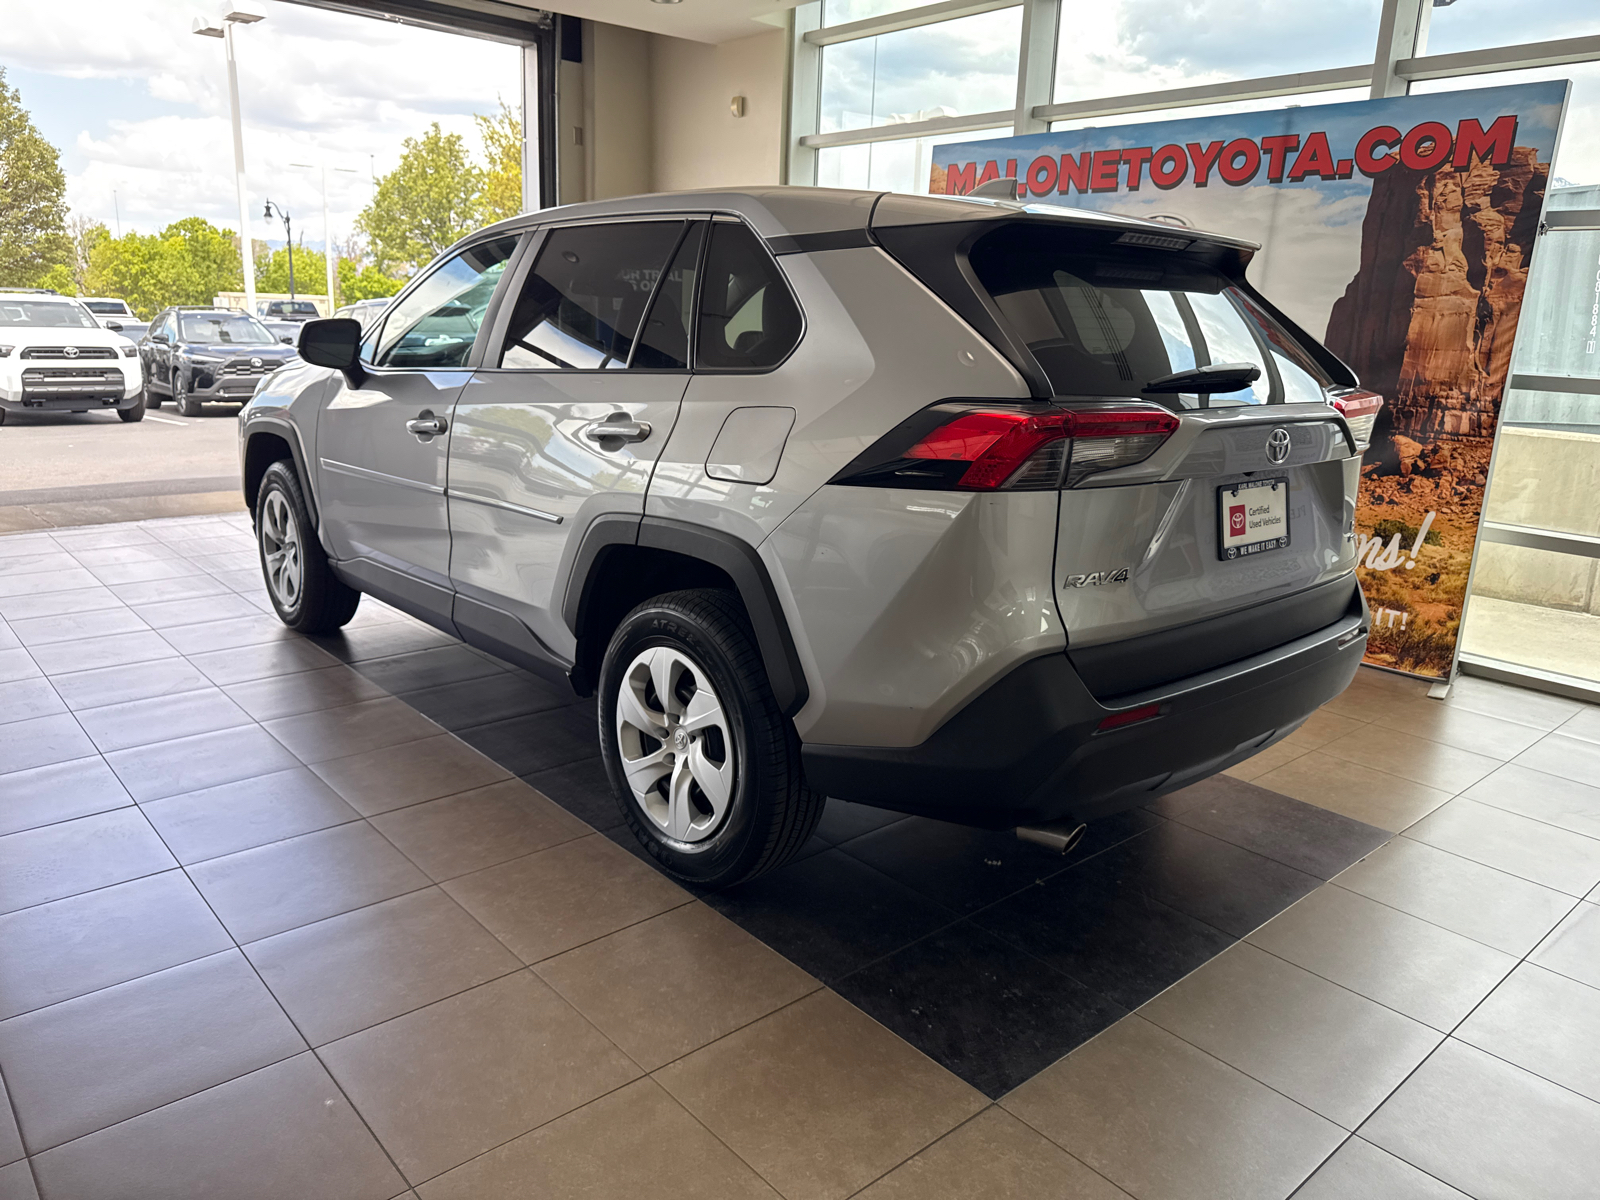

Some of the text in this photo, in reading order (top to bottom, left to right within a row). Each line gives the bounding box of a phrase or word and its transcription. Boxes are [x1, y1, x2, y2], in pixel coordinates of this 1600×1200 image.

[643, 269, 682, 281] TRAL
[1249, 504, 1270, 517] Certified
[1249, 516, 1281, 529] Used Vehicles
[1240, 540, 1276, 555] WE MAKE IT EASY
[1355, 511, 1436, 571] ns!
[1063, 567, 1130, 590] RAV4
[1375, 607, 1409, 631] IT!
